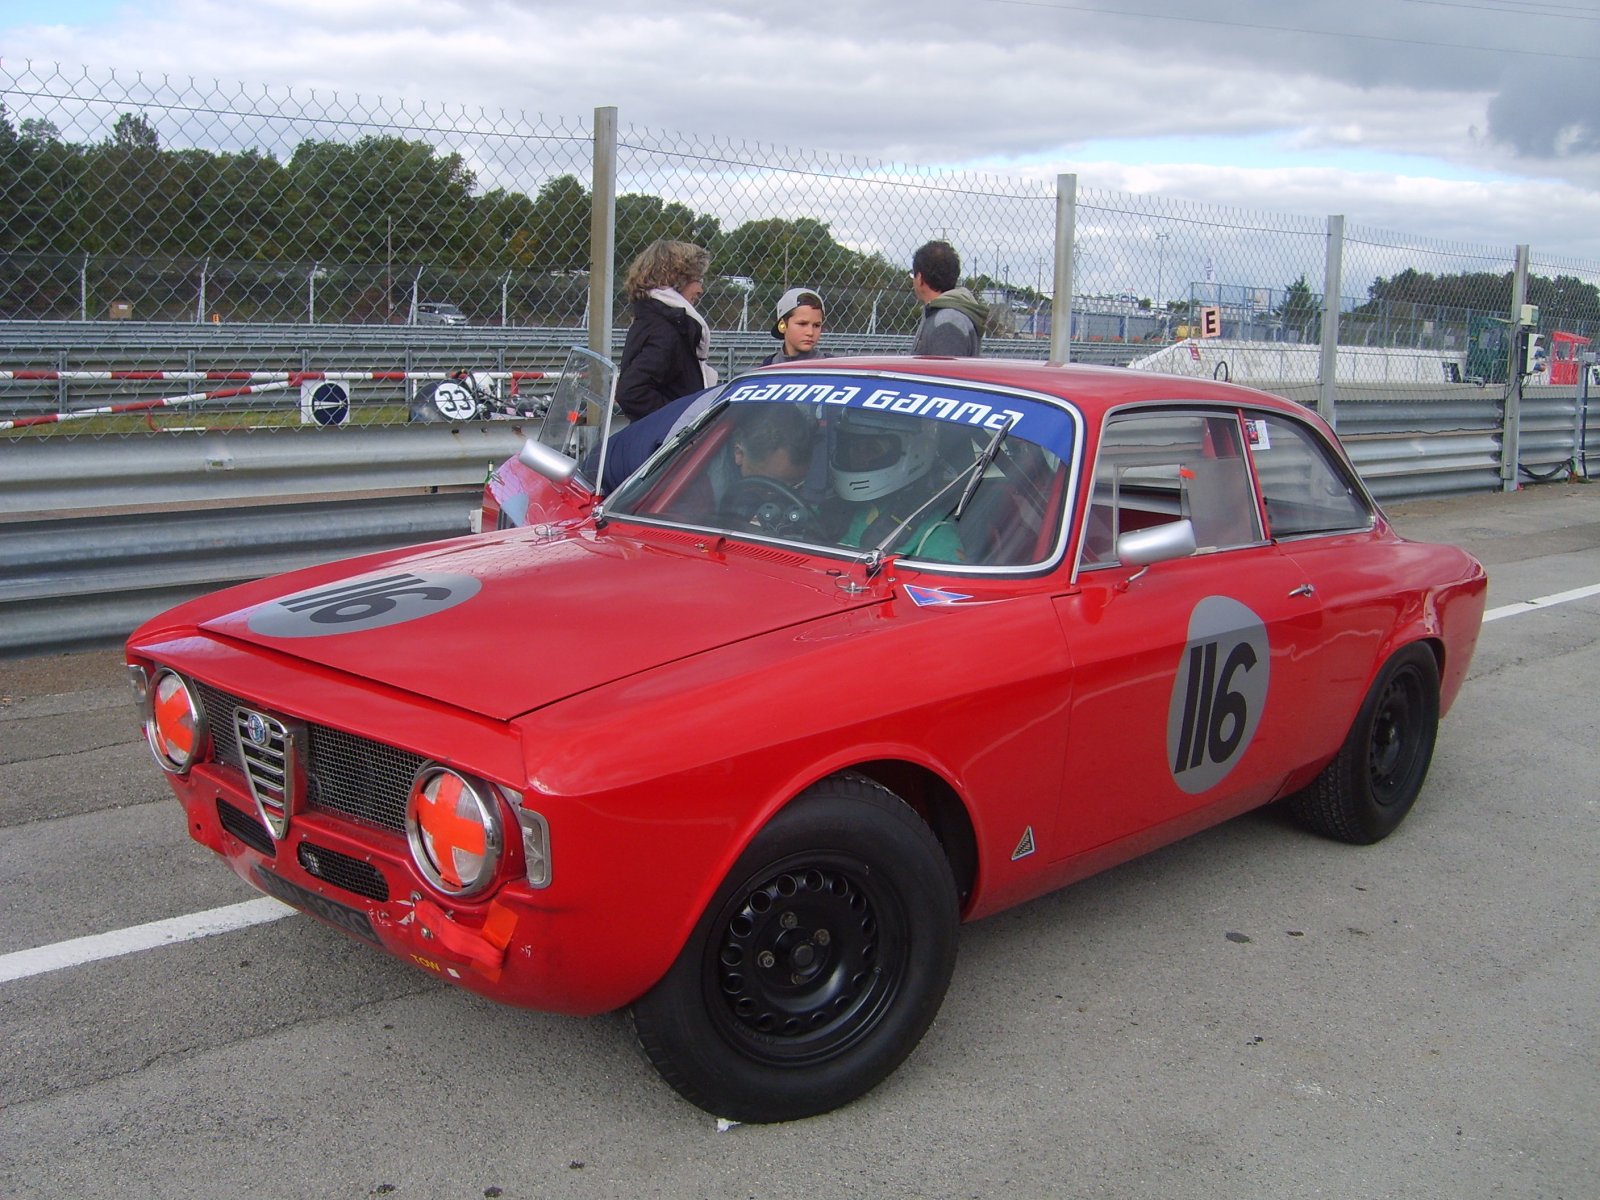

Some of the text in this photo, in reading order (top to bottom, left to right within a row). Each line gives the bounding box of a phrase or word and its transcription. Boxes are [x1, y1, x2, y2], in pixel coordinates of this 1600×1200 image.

[1206, 310, 1216, 334] E
[439, 389, 472, 412] 33
[278, 573, 452, 624] 116
[1174, 641, 1257, 774] 116
[410, 953, 440, 972] TOW
